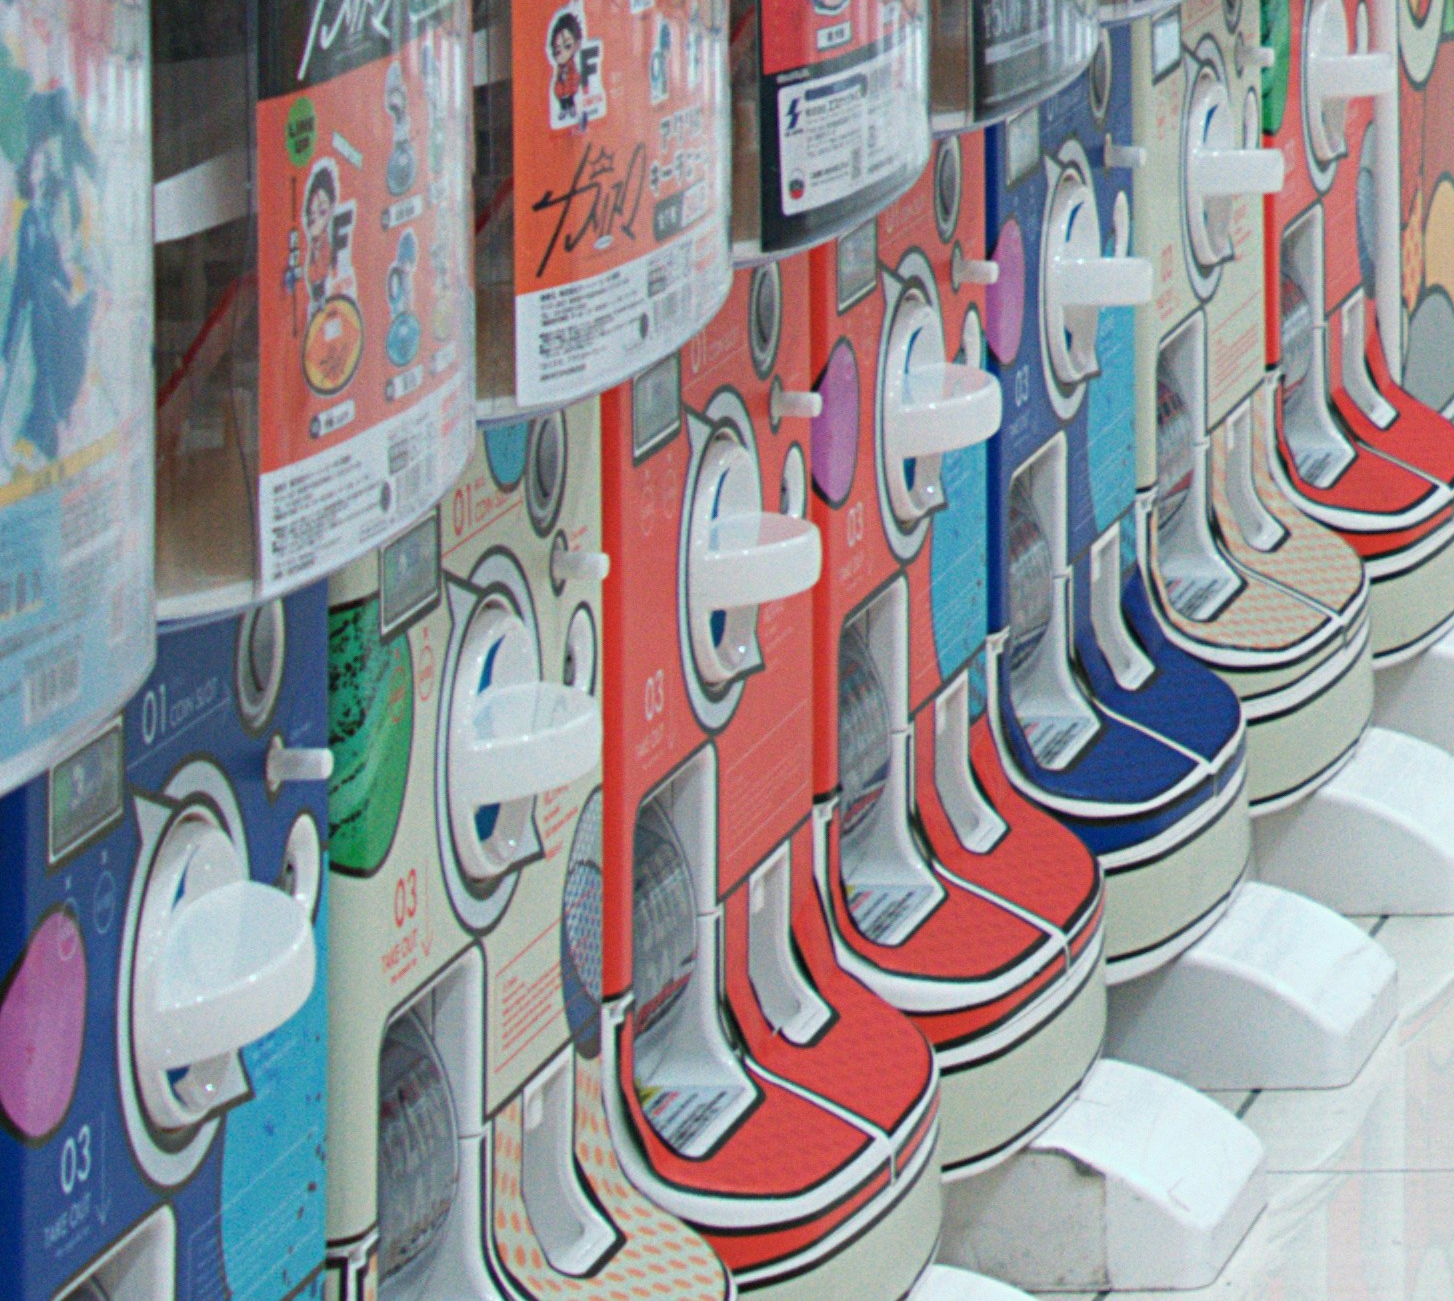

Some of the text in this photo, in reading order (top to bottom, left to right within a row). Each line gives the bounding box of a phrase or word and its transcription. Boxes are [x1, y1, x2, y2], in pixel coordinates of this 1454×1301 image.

[141, 697, 166, 743] 01
[394, 869, 417, 926] 03
[60, 1126, 91, 1193] 03
